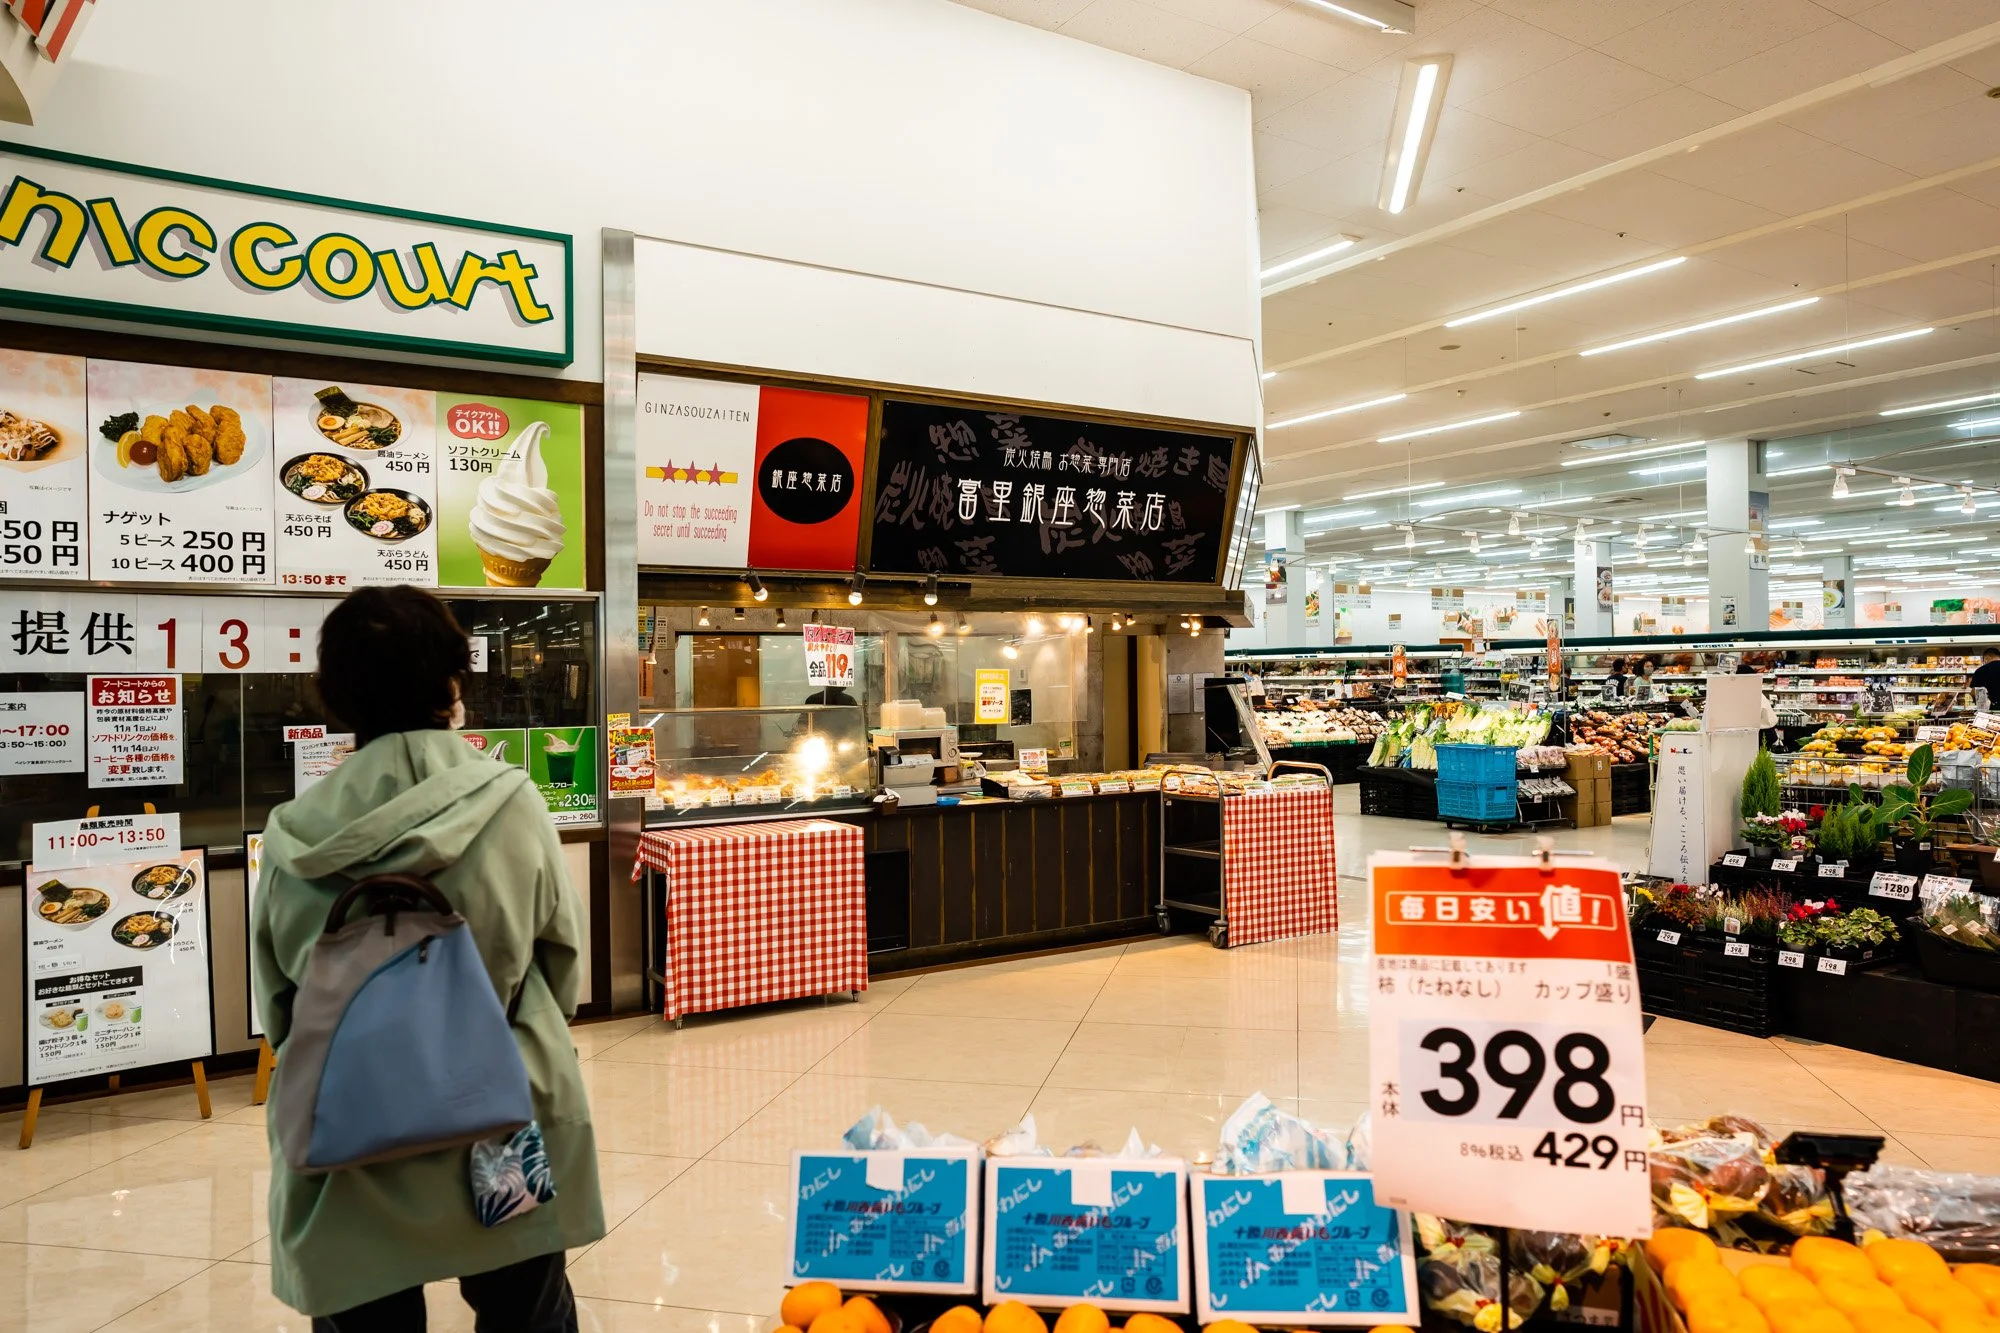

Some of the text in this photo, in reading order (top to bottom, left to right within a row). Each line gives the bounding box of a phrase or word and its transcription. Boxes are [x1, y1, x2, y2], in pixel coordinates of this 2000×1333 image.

[229, 221, 554, 323] court
[455, 409, 501, 420] テイクアウト
[645, 402, 749, 422] GINZASOUZAITEN
[455, 419, 500, 435] OK!!
[448, 445, 521, 459] ソフトクリーム
[449, 458, 492, 473] 130円
[772, 469, 842, 492] 銀座惣菜店
[645, 500, 737, 523] Do not stop the succeeding
[957, 478, 1166, 531] 富里銀座惣菜店
[103, 511, 171, 525] ナゲット
[285, 514, 332, 523] 天ぷらそば
[0, 520, 78, 542] 50 円
[653, 523, 726, 542] secret until succeeding
[134, 533, 175, 547] ピース
[182, 530, 234, 550] 250
[242, 532, 265, 552] 円
[0, 545, 79, 566] 50 円
[111, 553, 265, 574] 10 ピース 400 円
[377, 549, 429, 559] 天ぷらうどん
[282, 574, 347, 585] 13:50 まで
[11, 610, 135, 656] 提供
[98, 689, 171, 704] お知らせ
[288, 728, 323, 739] 新商品
[1884, 883, 1910, 894] 1280
[69, 973, 111, 984] お得なセット
[1536, 980, 1632, 1004] カップ盛り
[1382, 1082, 1399, 1118] 本体
